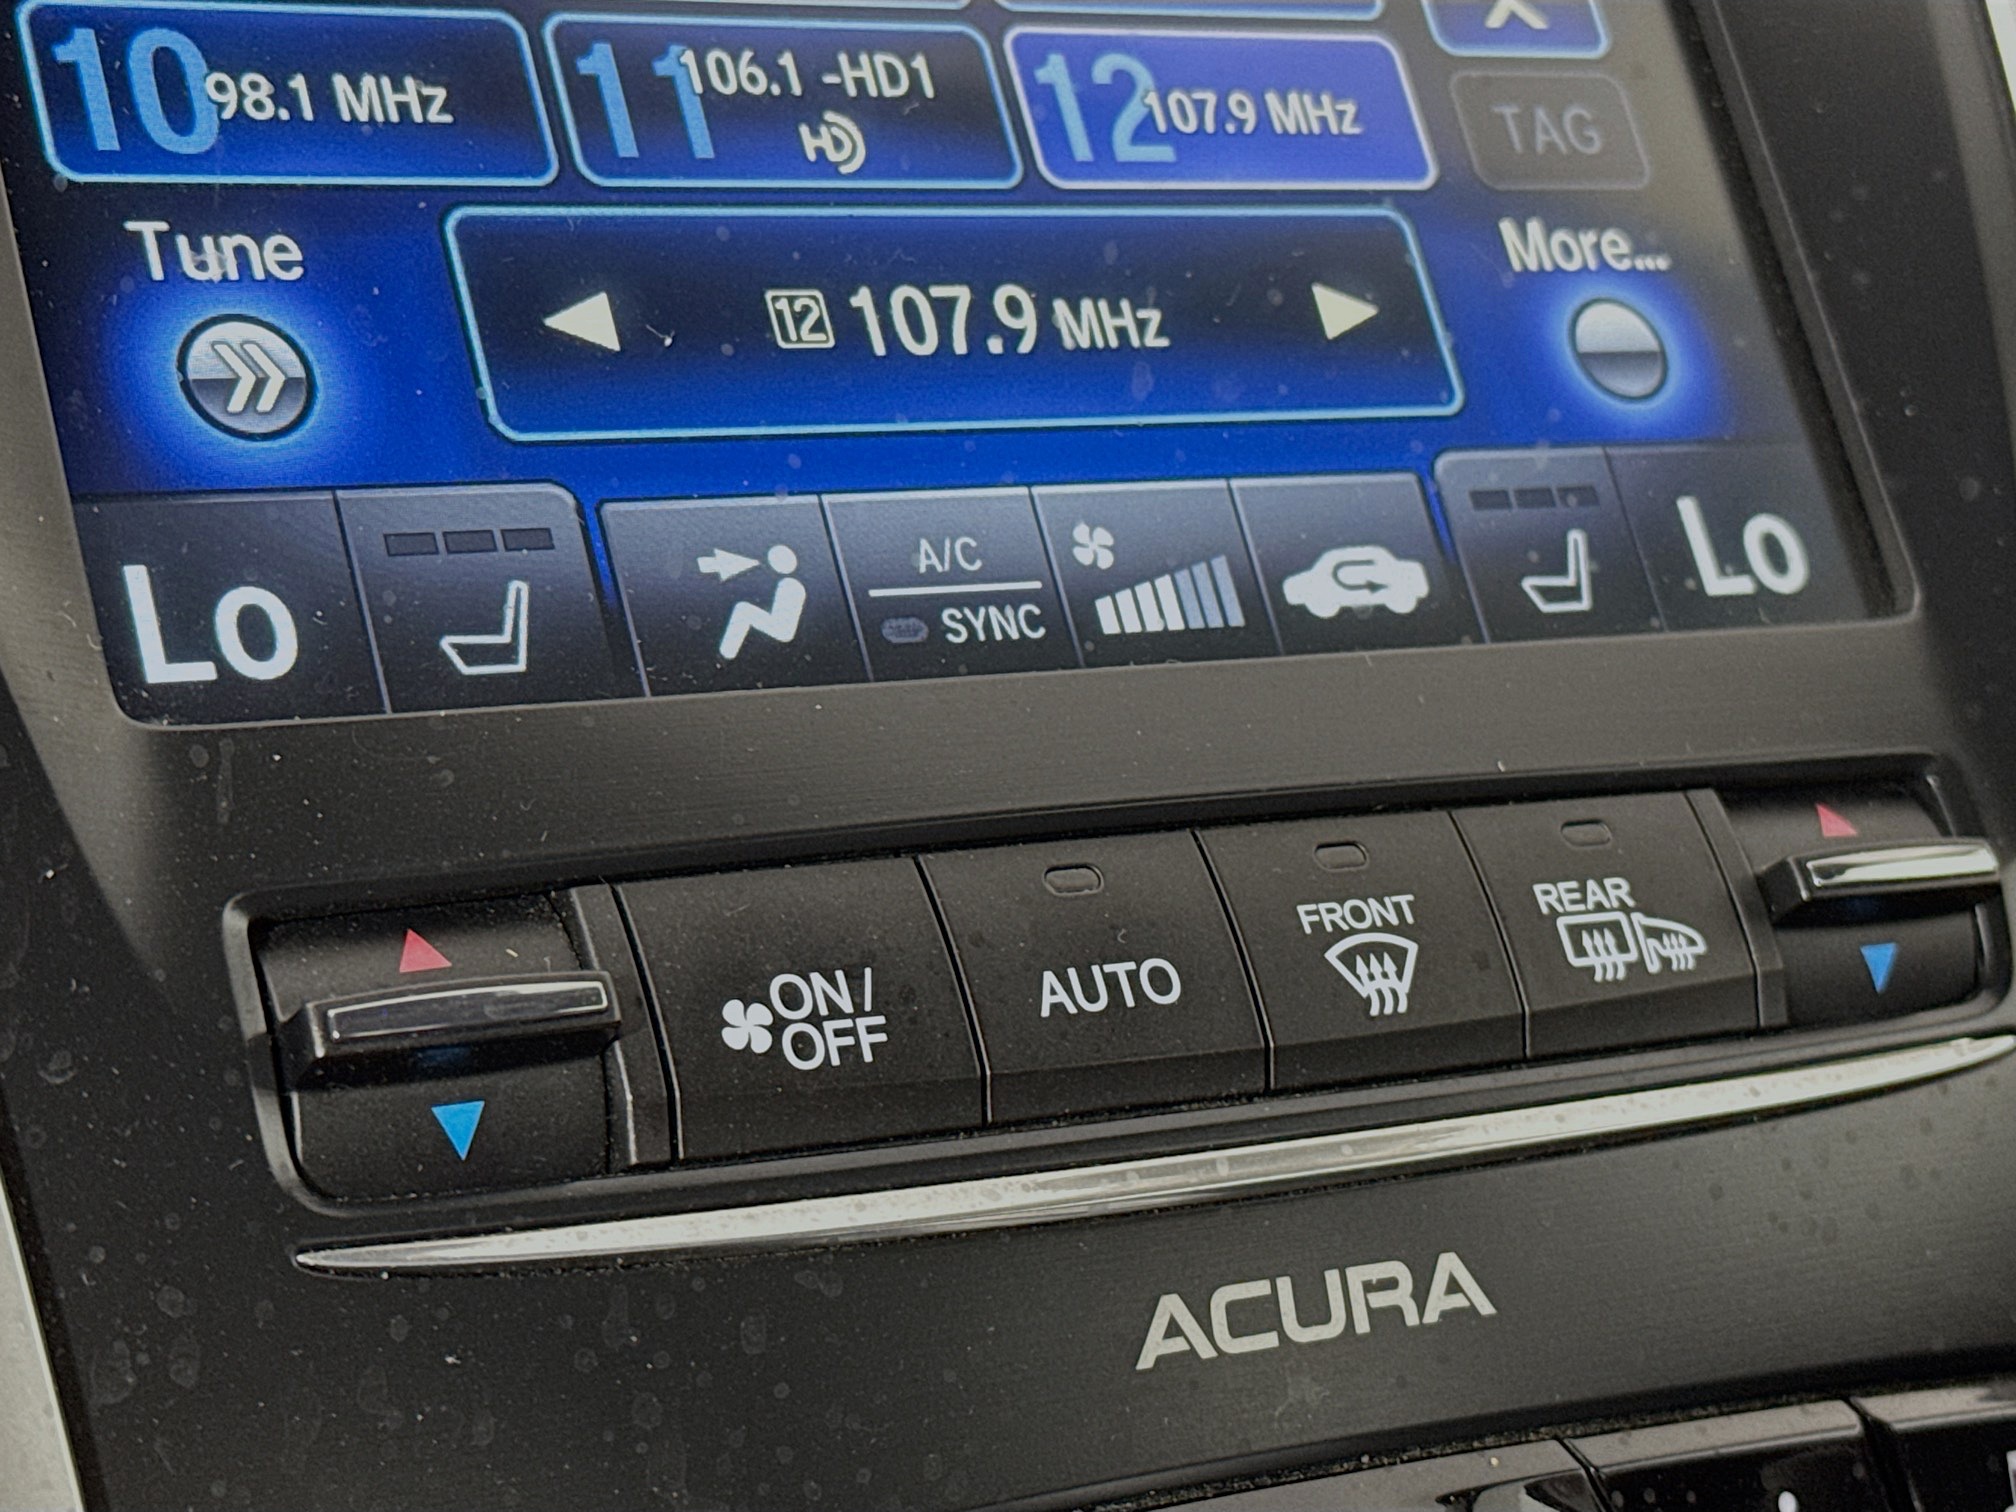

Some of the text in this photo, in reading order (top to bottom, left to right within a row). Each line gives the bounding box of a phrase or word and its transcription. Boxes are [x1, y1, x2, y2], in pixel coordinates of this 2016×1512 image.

[52, 26, 220, 155] 10
[205, 72, 455, 124] 98.1 MHz
[575, 41, 715, 159] 11
[680, 49, 936, 100] 106.1 -HD1
[1034, 52, 1178, 163] 12
[1143, 90, 1364, 136] 107.9 MHz
[1492, 104, 1601, 156] TAG
[123, 219, 304, 281] Tune
[1500, 216, 1672, 273] More...
[774, 283, 1171, 357] 12 107.9 MHz
[917, 536, 983, 574] A/C
[1676, 495, 1810, 597] Lo
[121, 564, 299, 684] Lo
[940, 602, 1047, 645] SYNC
[1296, 894, 1415, 934] FRONT
[1532, 876, 1636, 915] REAR
[768, 966, 873, 1020] ON/
[1040, 957, 1182, 1018] AUTO
[781, 1014, 889, 1070] OFF
[1135, 1250, 1498, 1371] ACURA
